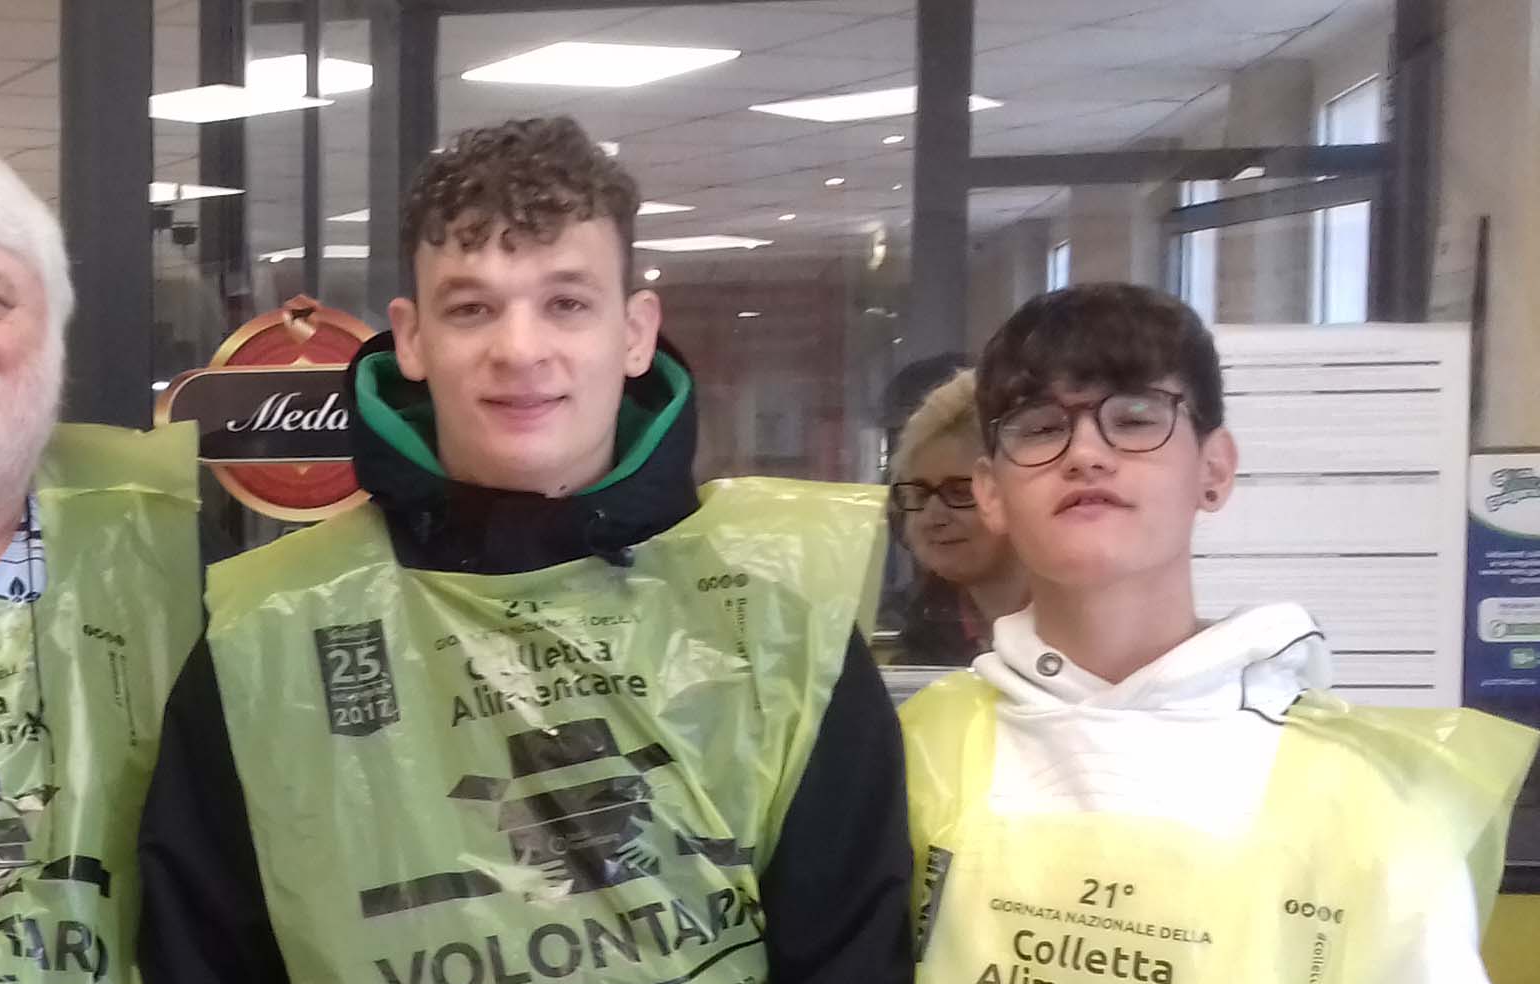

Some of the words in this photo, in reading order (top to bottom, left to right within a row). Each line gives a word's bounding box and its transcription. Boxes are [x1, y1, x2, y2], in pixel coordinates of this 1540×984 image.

[326, 648, 381, 685] 25
[332, 700, 397, 727] 2017
[1078, 878, 1136, 909] 21°
[989, 898, 1061, 921] GIORNATA
[1064, 911, 1155, 938] NAZIONALE
[1159, 926, 1213, 945] DELLA
